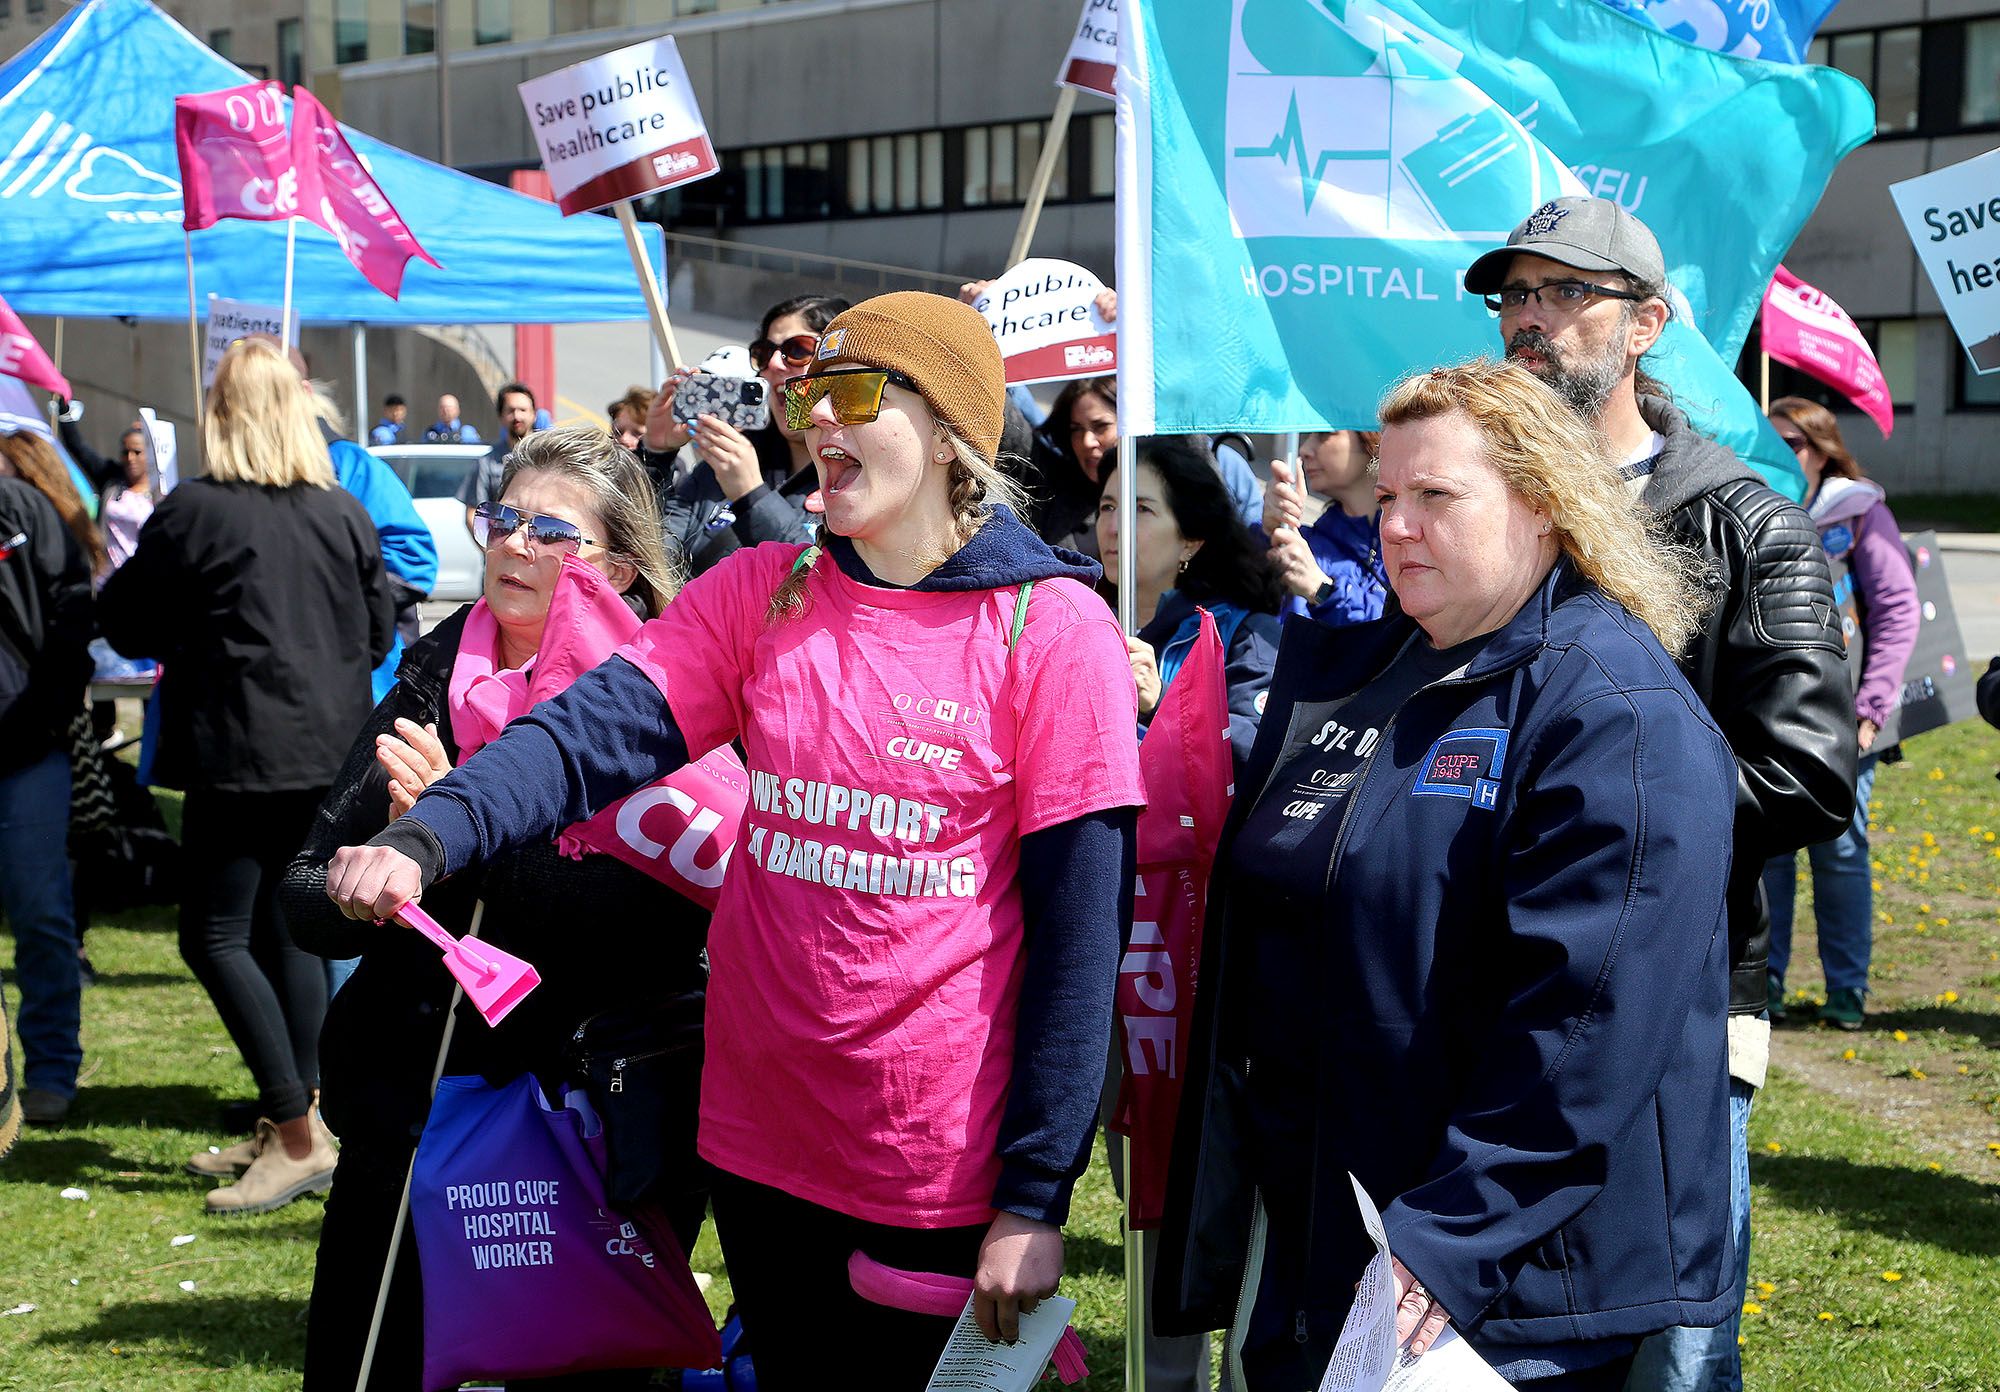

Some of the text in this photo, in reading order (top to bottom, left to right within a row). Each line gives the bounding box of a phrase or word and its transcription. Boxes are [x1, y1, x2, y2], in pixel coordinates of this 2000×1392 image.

[535, 67, 670, 127] Save public
[546, 112, 665, 161] healthcare
[1923, 197, 2000, 243] Save
[1240, 262, 1440, 302] HOSPITAL
[1946, 258, 2000, 296] he
[891, 692, 982, 727] OCHU
[886, 736, 964, 771] CUPE
[1436, 754, 1480, 769] CUPE
[696, 760, 750, 797] OUNCI
[1431, 767, 1462, 779] 1943
[751, 769, 949, 844] WE SUPPORT
[1282, 800, 1326, 821] CUPE
[766, 831, 977, 898] BARGAINING
[446, 1180, 559, 1211] PROUD CUPE
[463, 1211, 556, 1240] HOSPITAL
[471, 1241, 553, 1270] WORKER
